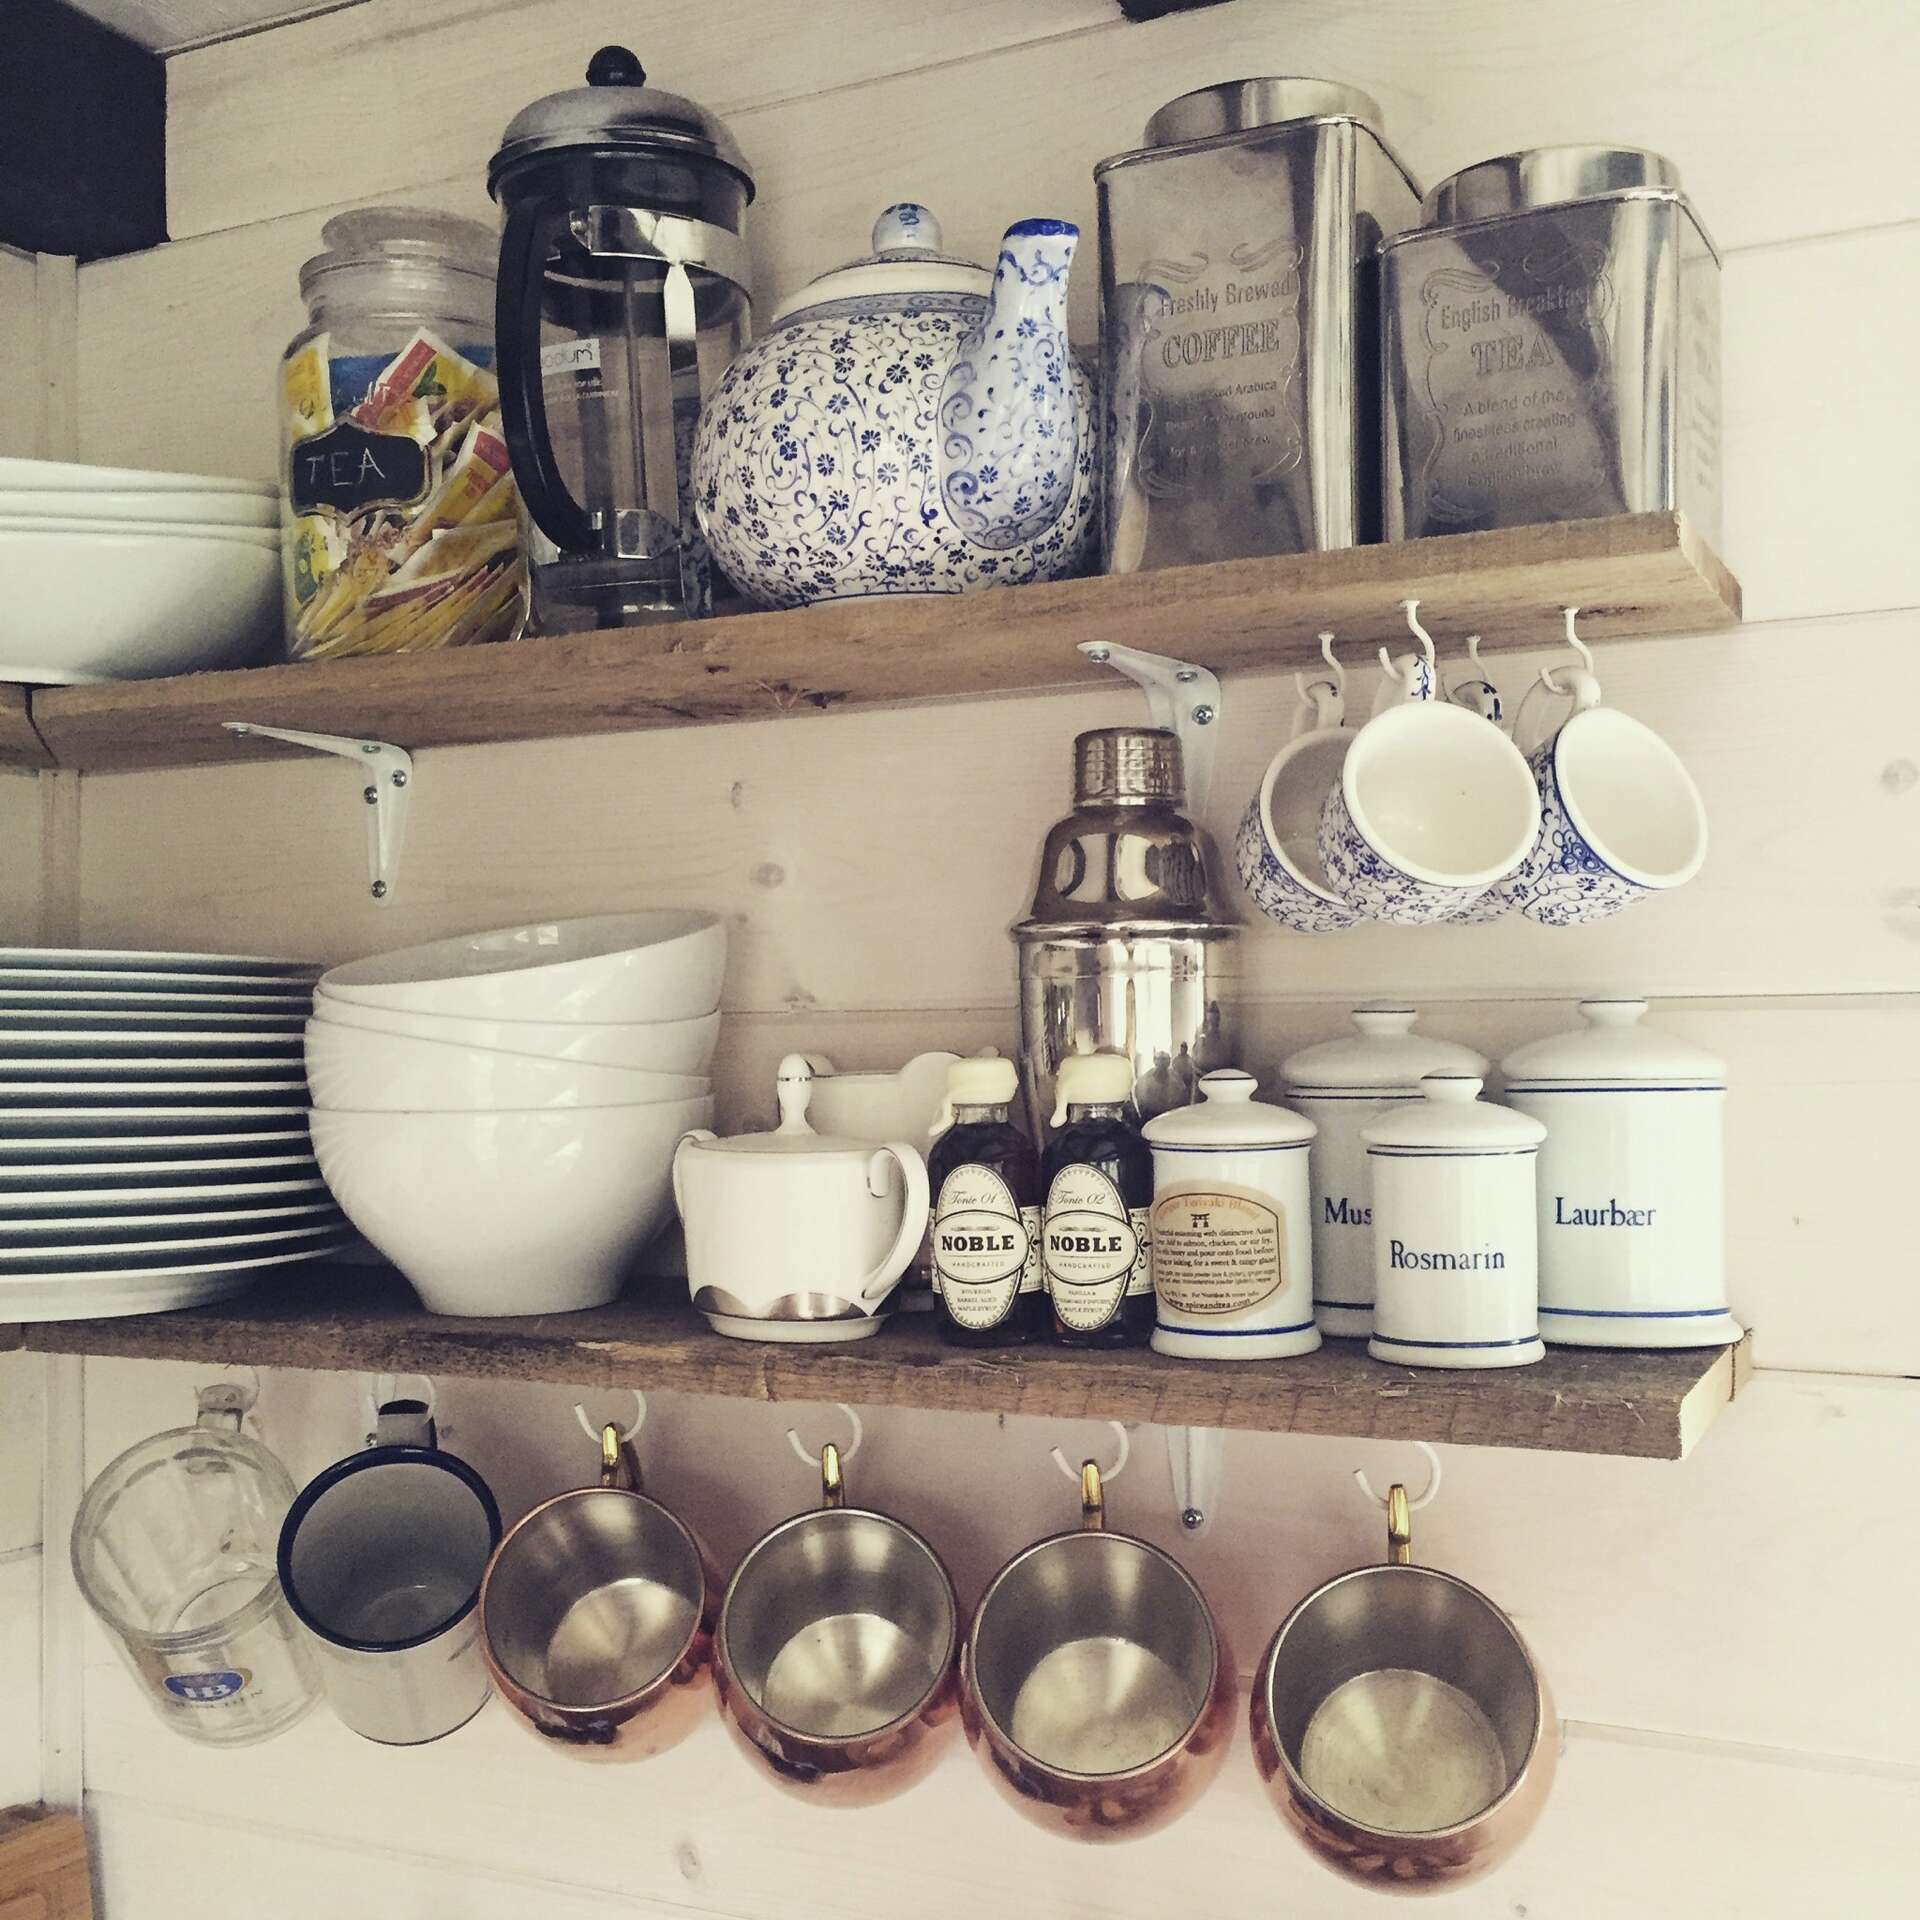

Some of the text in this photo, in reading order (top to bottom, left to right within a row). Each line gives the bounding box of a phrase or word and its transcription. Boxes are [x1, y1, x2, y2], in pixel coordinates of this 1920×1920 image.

[1226, 277, 1293, 306] Brewed
[1441, 295, 1500, 331] English
[1162, 319, 1280, 368] COFFEE
[1471, 332, 1554, 376] TEA
[304, 447, 385, 487] TEA
[950, 1190, 977, 1205] Tonic
[1056, 1190, 1106, 1205] Tonic 02
[1555, 1197, 1657, 1227] Laurbær
[941, 1234, 1015, 1252] NOBLE
[1050, 1235, 1122, 1253] NOBLE
[1390, 1240, 1505, 1271] Rosmarin
